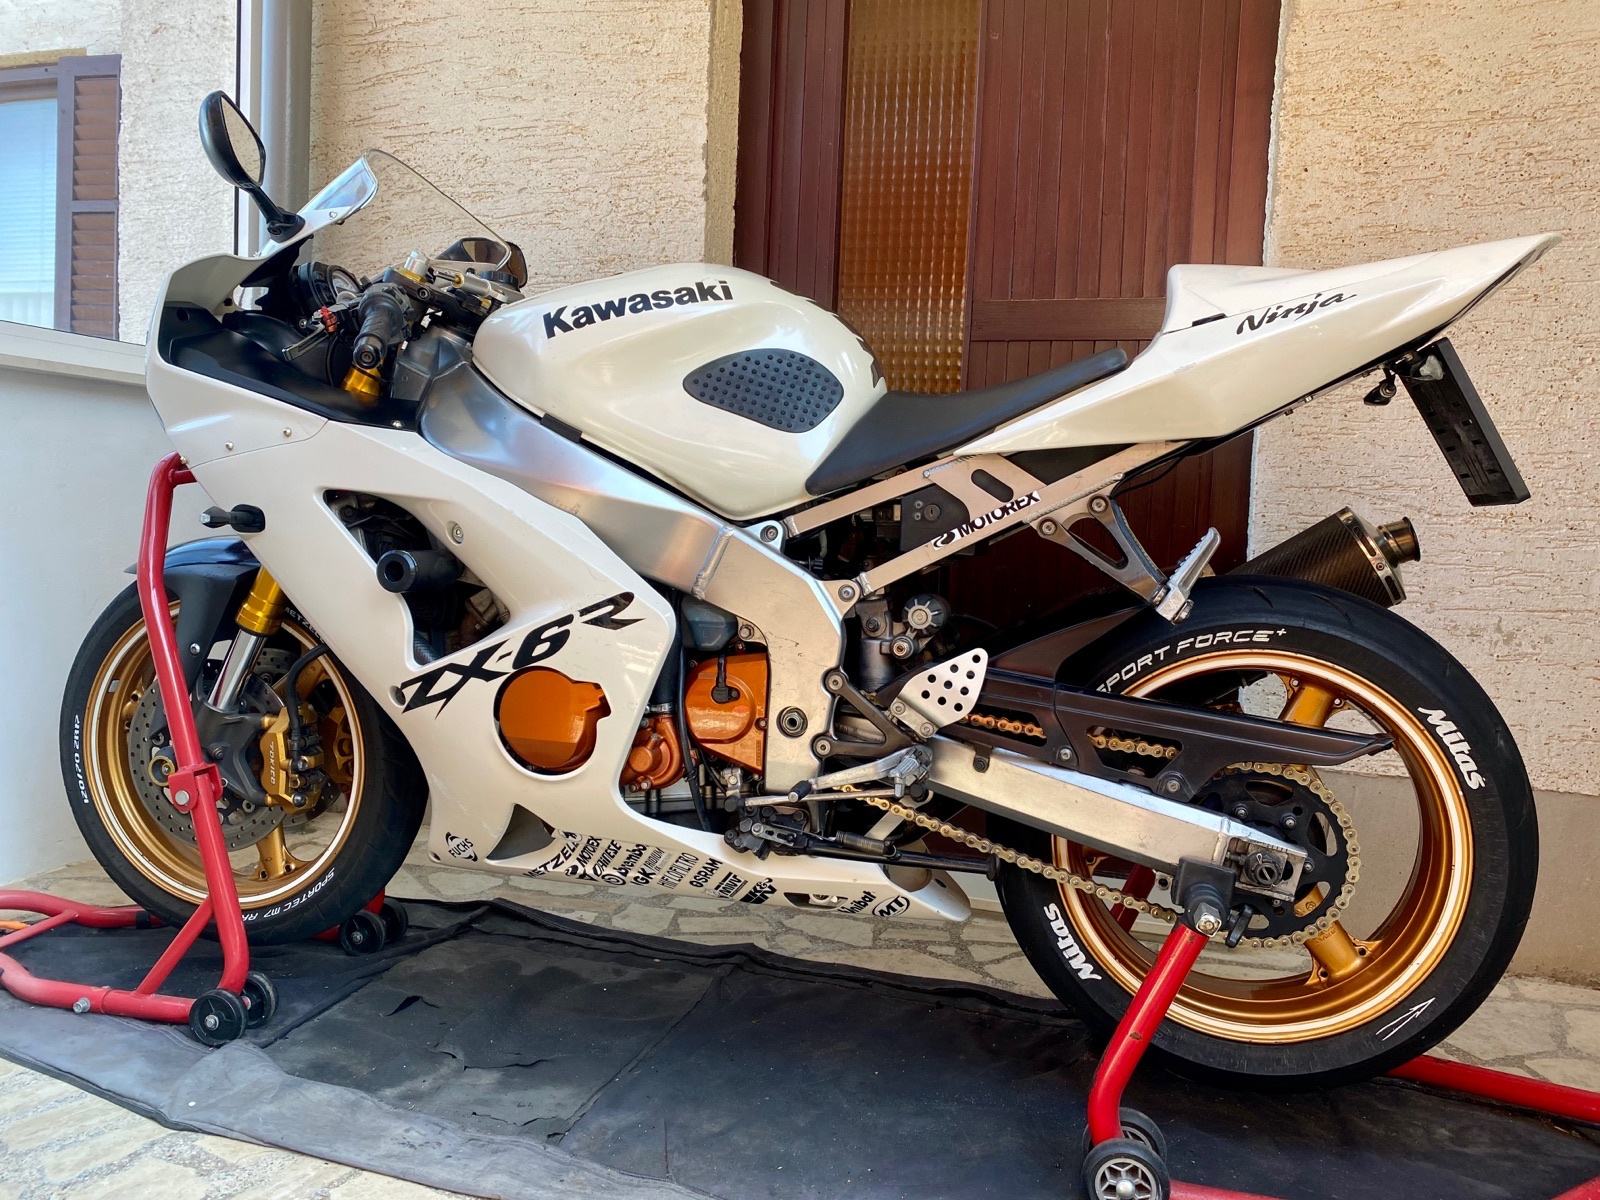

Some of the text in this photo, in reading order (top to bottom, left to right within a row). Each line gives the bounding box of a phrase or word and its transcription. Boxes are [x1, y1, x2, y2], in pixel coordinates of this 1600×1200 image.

[543, 281, 733, 339] Kawasaki
[1236, 293, 1357, 335] Ninja
[957, 492, 1041, 537] MOTOREX
[400, 591, 645, 720] ZX-6R
[268, 741, 277, 785] TOKICO
[1417, 706, 1486, 790] Mitas
[448, 838, 474, 858] FUCHS
[613, 843, 647, 877] brembo
[283, 867, 336, 912] SPORTEC
[689, 857, 723, 888] OSRAM
[878, 895, 904, 917] MT
[1043, 902, 1102, 980] Mitas
